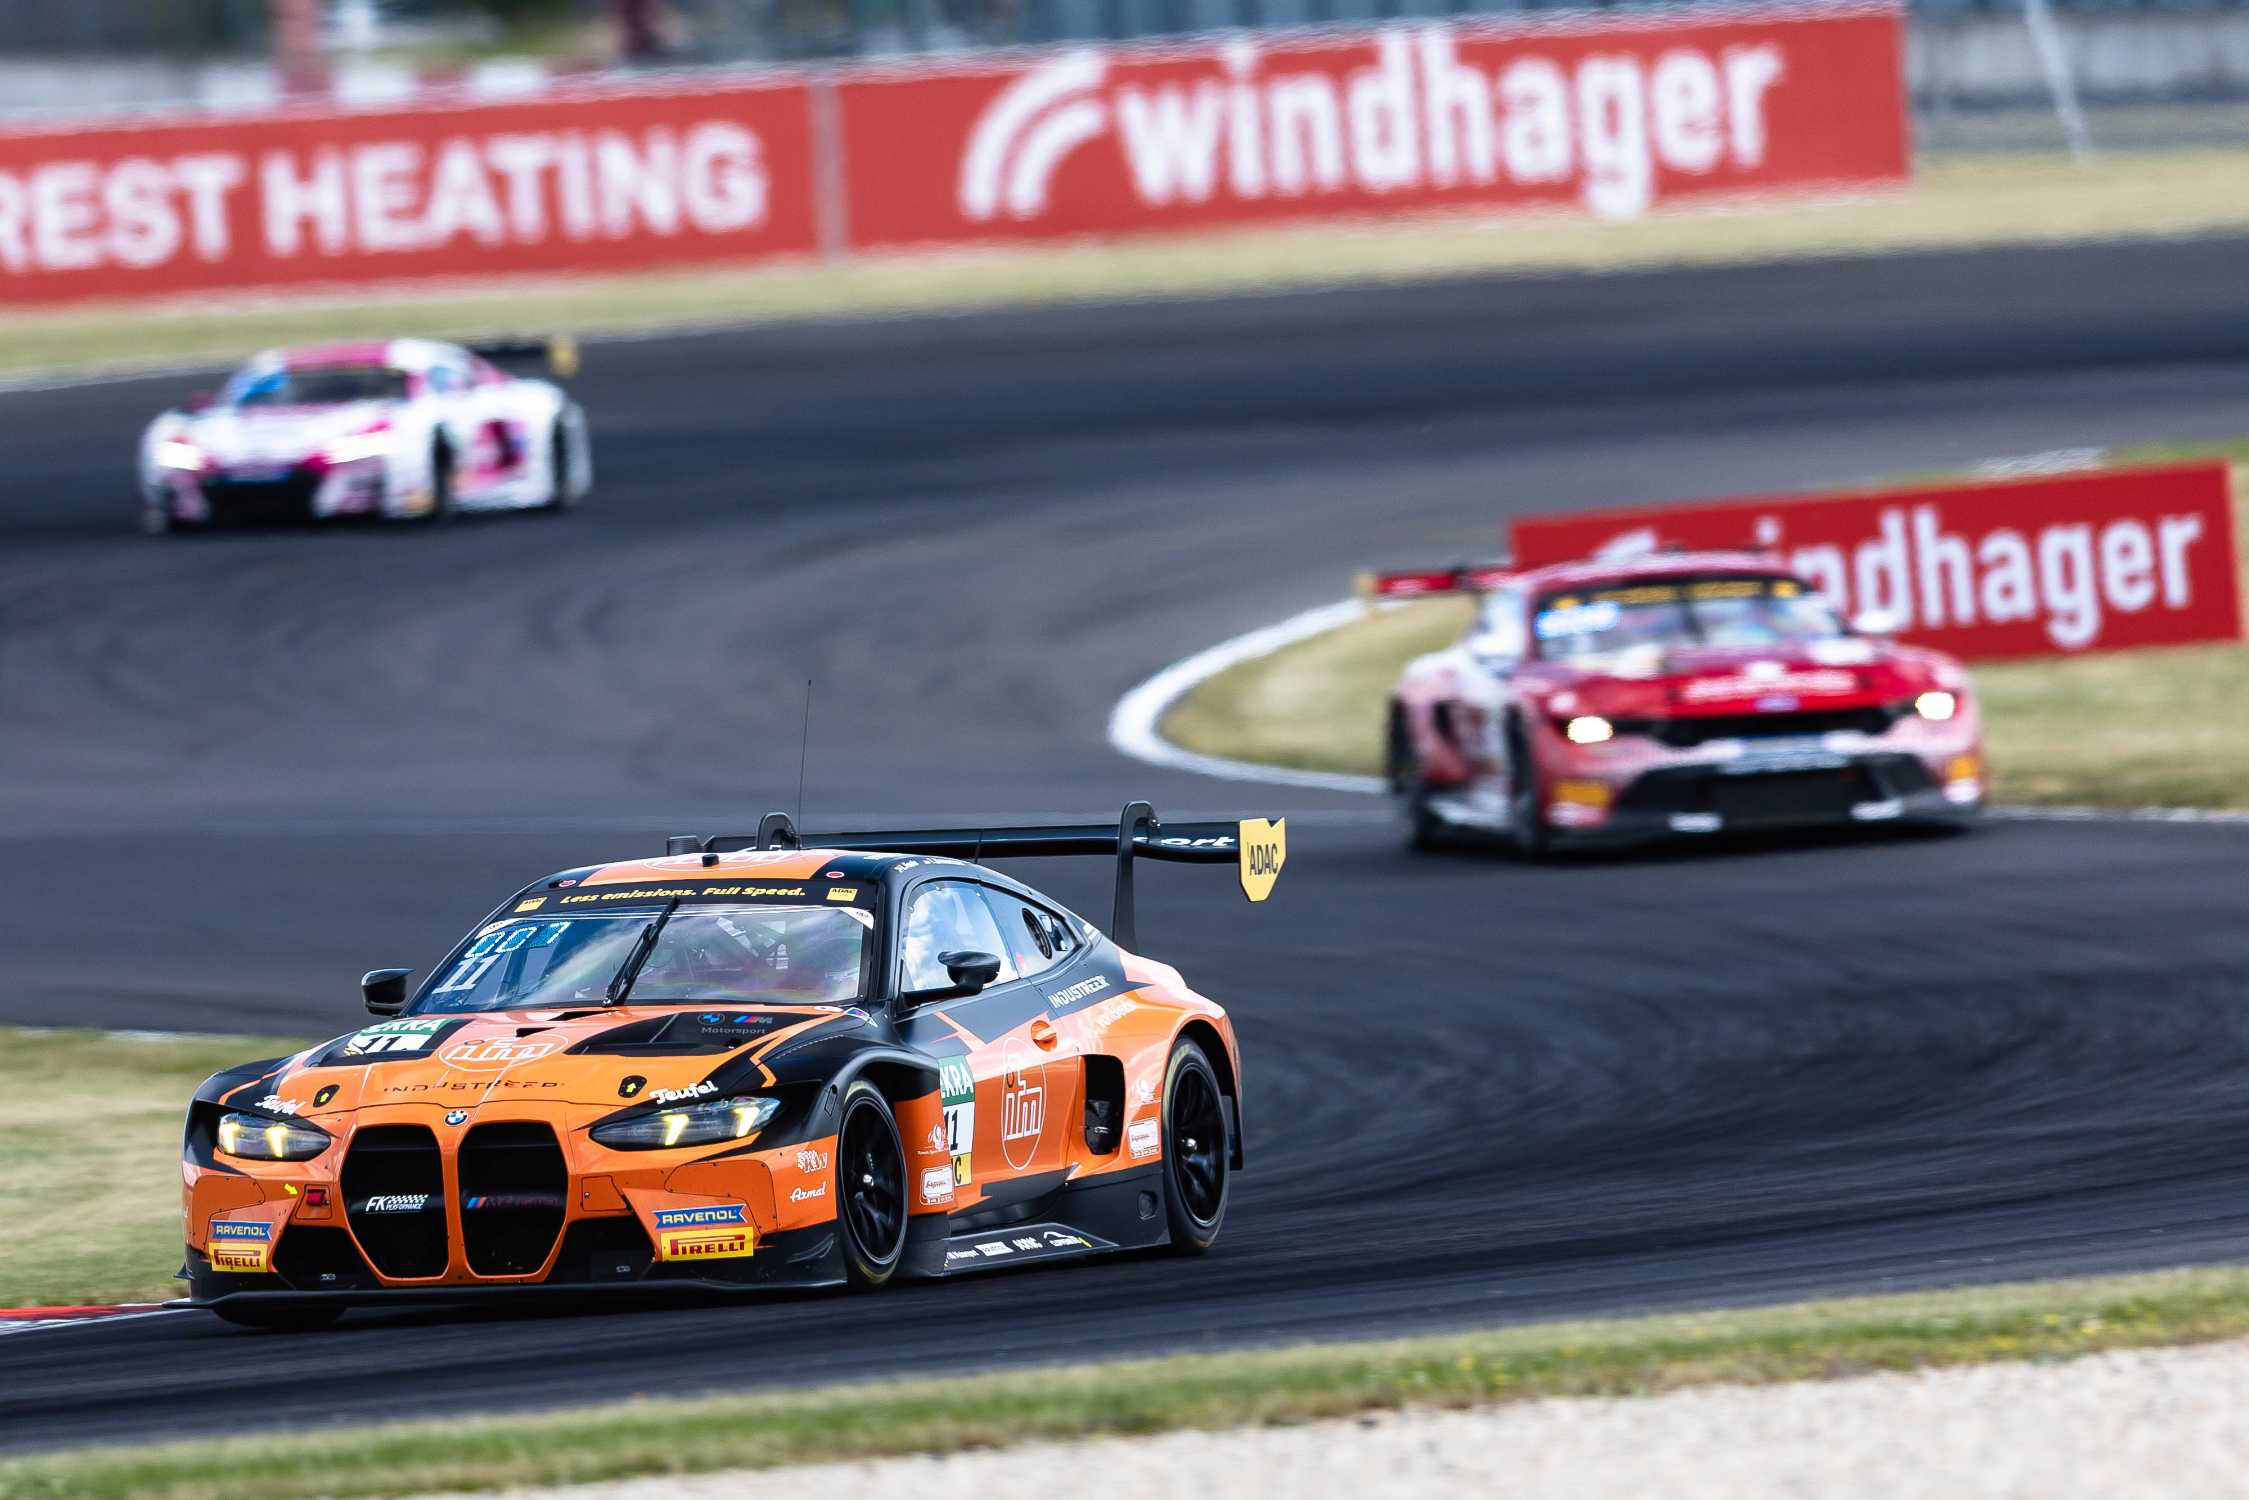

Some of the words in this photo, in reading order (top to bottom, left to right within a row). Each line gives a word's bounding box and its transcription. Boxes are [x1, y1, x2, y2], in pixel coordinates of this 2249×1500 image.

[1108, 26, 1784, 220] windhager
[258, 120, 767, 257] HEATING
[1753, 503, 2202, 650] ndhager
[1249, 842, 1278, 876] ADAC
[560, 894, 601, 905] Less
[601, 887, 697, 901] emissions.
[702, 886, 742, 897] Full
[742, 886, 806, 898] Speed.
[431, 953, 501, 994] 11
[701, 1026, 768, 1036] Motorsport
[648, 1080, 719, 1105] Teufel
[940, 1063, 974, 1099] KRA
[365, 1196, 391, 1212] FK
[662, 1209, 738, 1225] RAVENOL
[215, 1224, 268, 1237] RAVENOL
[669, 1234, 746, 1256] PIRELLI
[213, 1249, 262, 1269] PIRELLI
